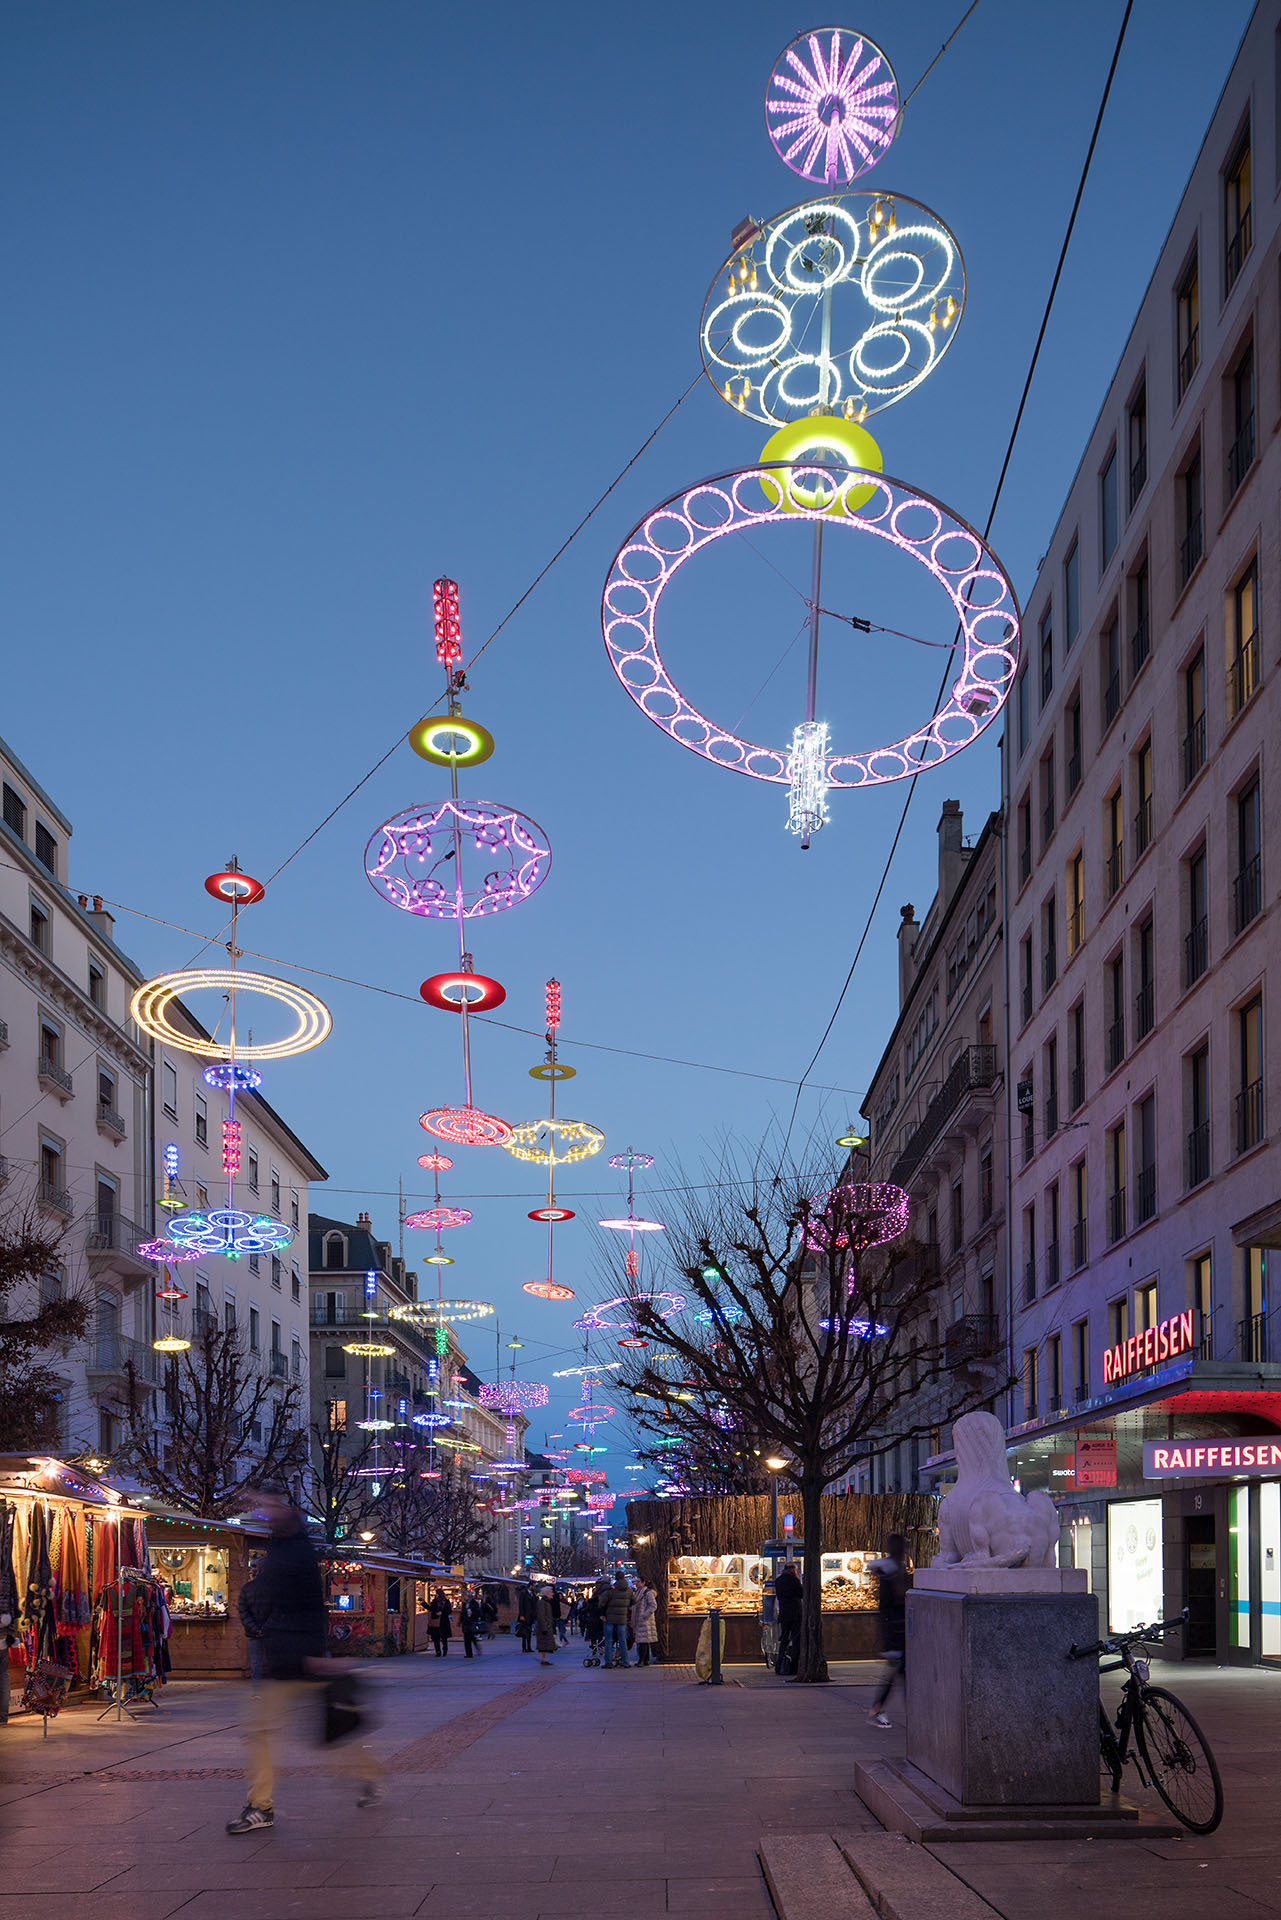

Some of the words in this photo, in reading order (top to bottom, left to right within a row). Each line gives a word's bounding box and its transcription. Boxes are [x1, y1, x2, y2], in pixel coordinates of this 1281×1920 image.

[1103, 1308, 1193, 1384] RAIFFEISEN
[1153, 1445, 1281, 1468] RAIFFEISEN
[1193, 1494, 1202, 1510] 19
